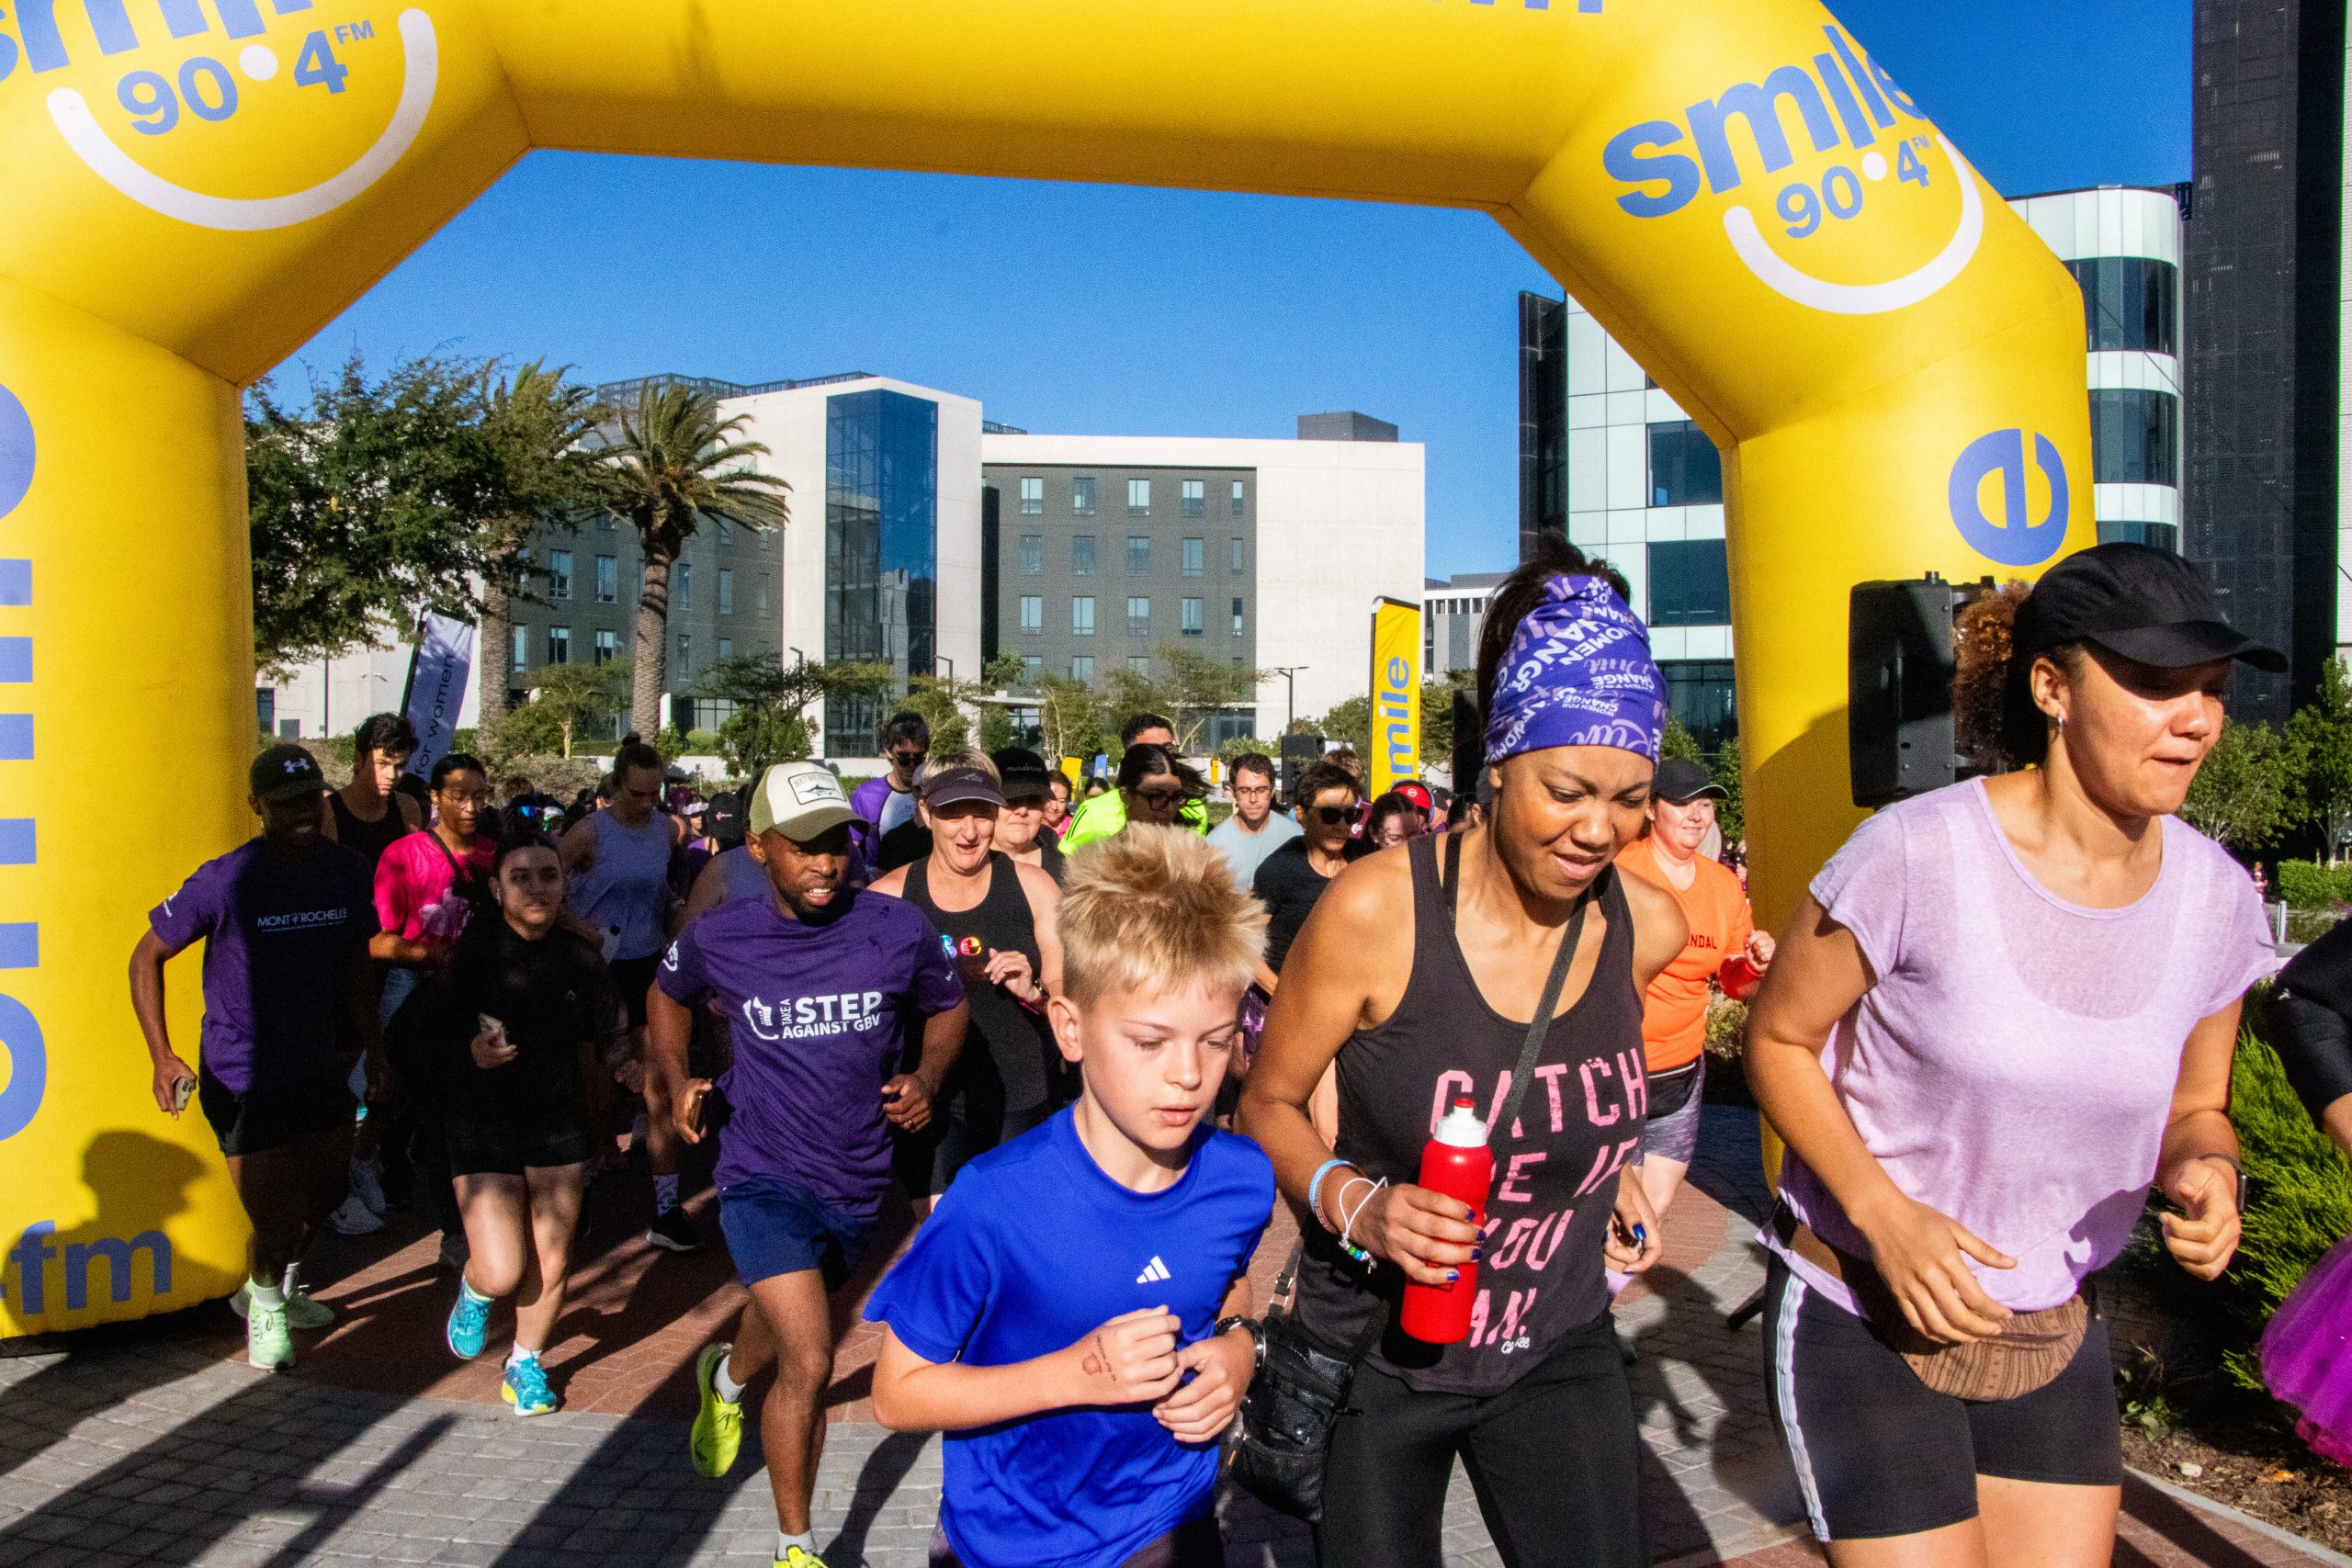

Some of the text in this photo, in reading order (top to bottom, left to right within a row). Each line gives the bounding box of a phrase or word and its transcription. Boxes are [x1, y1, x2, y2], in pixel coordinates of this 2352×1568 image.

[334, 19, 375, 45] FM
[427, 655, 455, 738] women
[1564, 694, 1619, 713] CHANGE
[1379, 656, 1413, 794] mile
[257, 915, 290, 928] MONT
[300, 908, 347, 923] ROCHELLE
[1689, 933, 1718, 950] NDAL
[780, 1005, 793, 1026] TAKE
[795, 991, 883, 1024] STEP
[782, 1013, 881, 1039] AGAINST GBV
[1430, 1047, 1646, 1139] CATCH
[0, 1220, 172, 1315] fm
